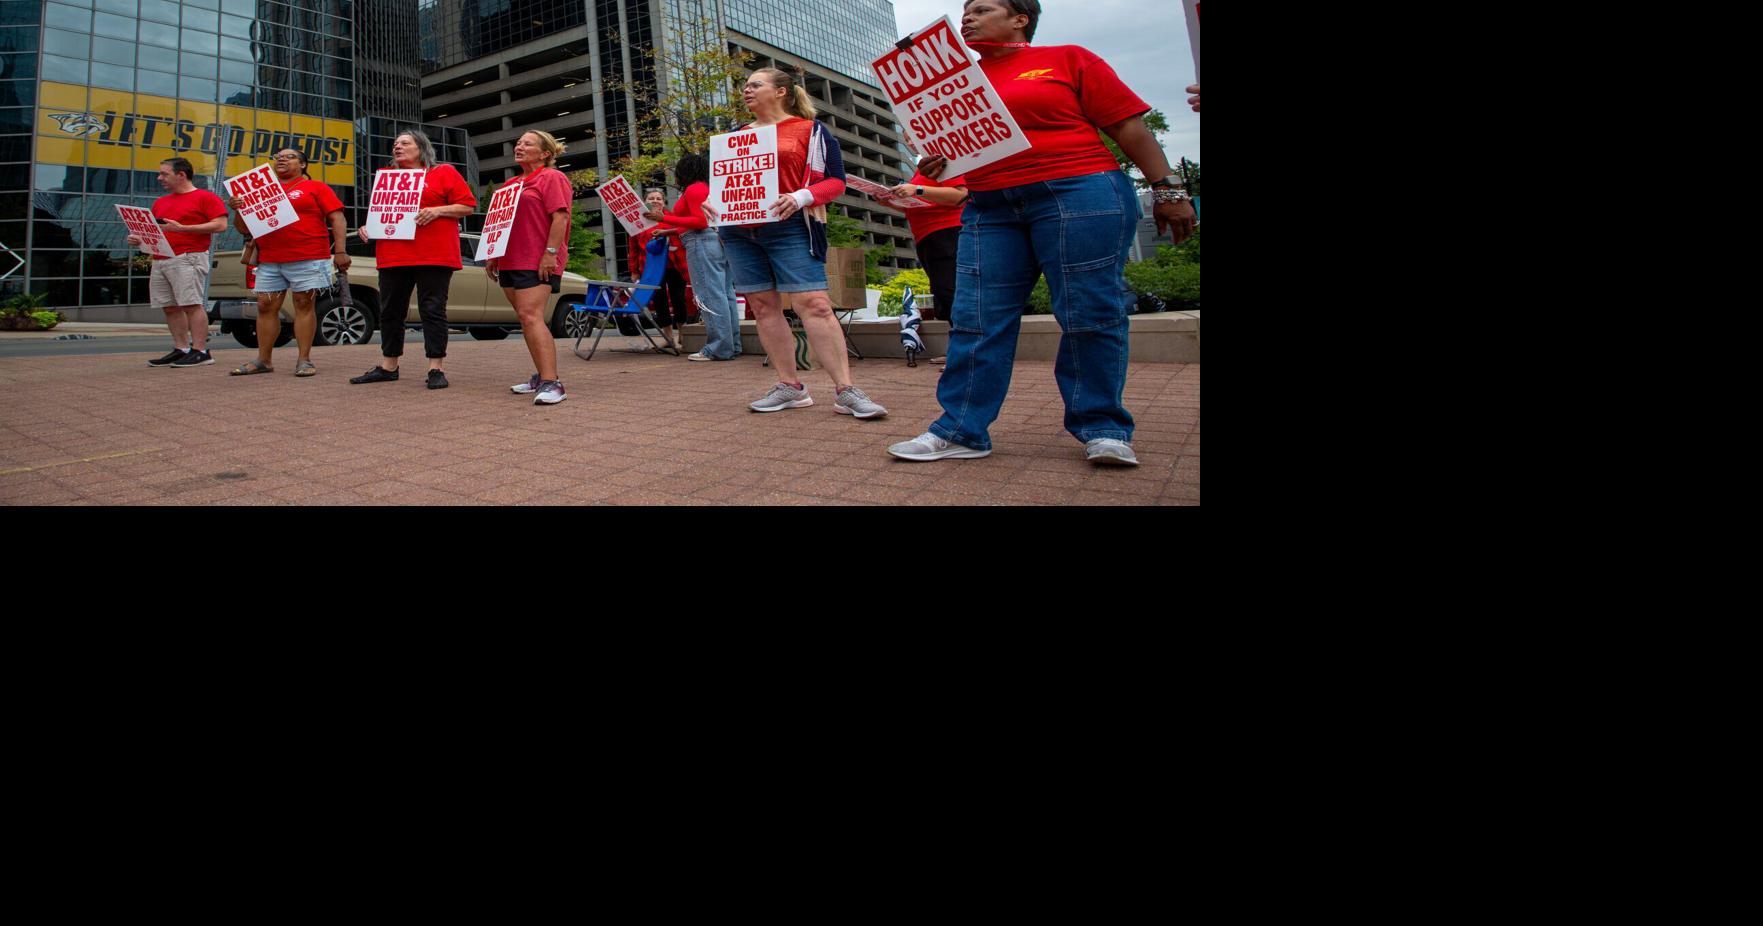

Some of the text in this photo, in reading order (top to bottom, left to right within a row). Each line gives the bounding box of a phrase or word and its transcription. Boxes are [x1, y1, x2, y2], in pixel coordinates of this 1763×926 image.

[876, 26, 967, 99] HONK
[907, 75, 970, 114] IF YOU
[909, 86, 993, 140] SUPPORT
[97, 111, 350, 166] LET'S GO PREDS!
[728, 132, 758, 148] CWA
[922, 112, 1012, 161] WORKERS
[737, 147, 750, 156] ON
[715, 154, 774, 175] STRIKE!
[229, 166, 273, 197] AT&T
[375, 172, 424, 191] AT&T
[725, 172, 763, 189] AT&T
[372, 192, 420, 205] UNFAIR
[490, 185, 520, 211] AT&T
[599, 178, 629, 204] AT&T
[721, 186, 766, 203] UNFAIR
[608, 192, 639, 213] UNFAIR
[728, 201, 759, 212] LABOR
[119, 207, 154, 224] AT&T
[256, 205, 278, 221] ULP
[380, 213, 404, 224] ULP
[485, 207, 515, 227] UNFAIR
[625, 210, 640, 223] ULP
[721, 210, 767, 222] PRACTICE
[125, 221, 161, 235] UNFAIR
[142, 236, 159, 245] ULP
[487, 231, 502, 244] ULP
